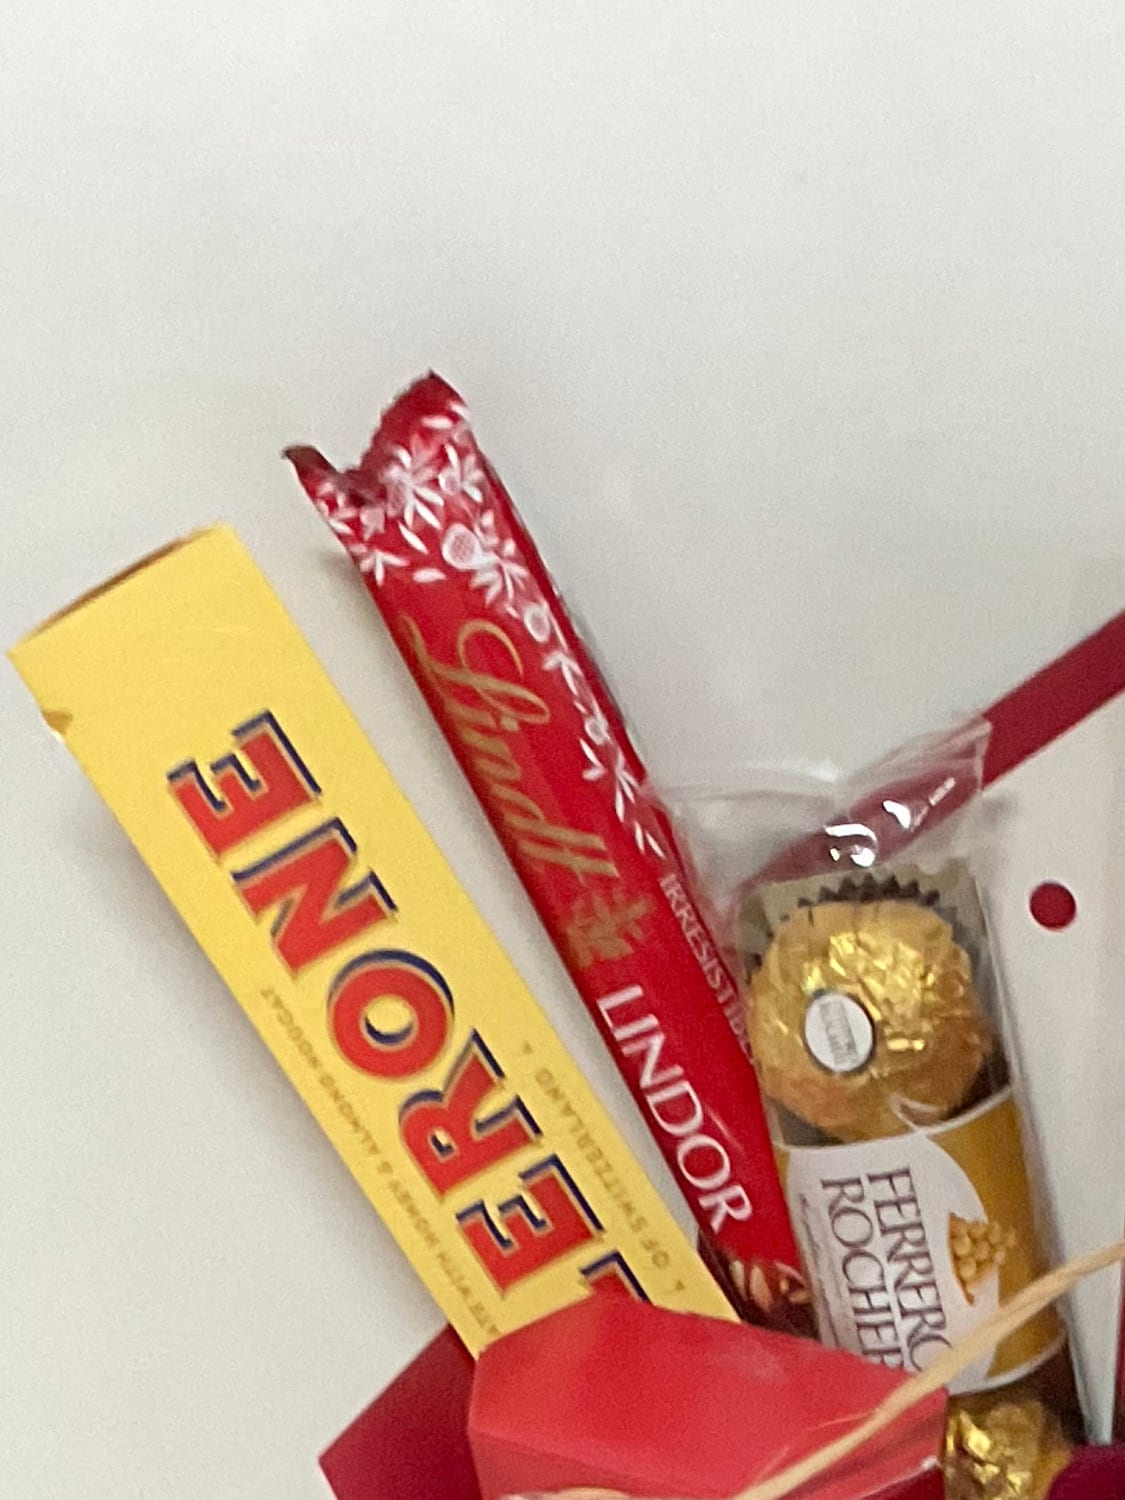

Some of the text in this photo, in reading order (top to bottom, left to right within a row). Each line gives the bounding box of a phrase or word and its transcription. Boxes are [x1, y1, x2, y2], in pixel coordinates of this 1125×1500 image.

[401, 613, 620, 878] Lindt
[260, 988, 320, 1069] NOUGAT
[319, 1075, 378, 1155] ALMOND
[597, 985, 752, 1232] LINDOR
[535, 1068, 670, 1269] OF SWITZERLAND
[389, 1180, 439, 1247] HONEY
[437, 1253, 471, 1297] WITH
